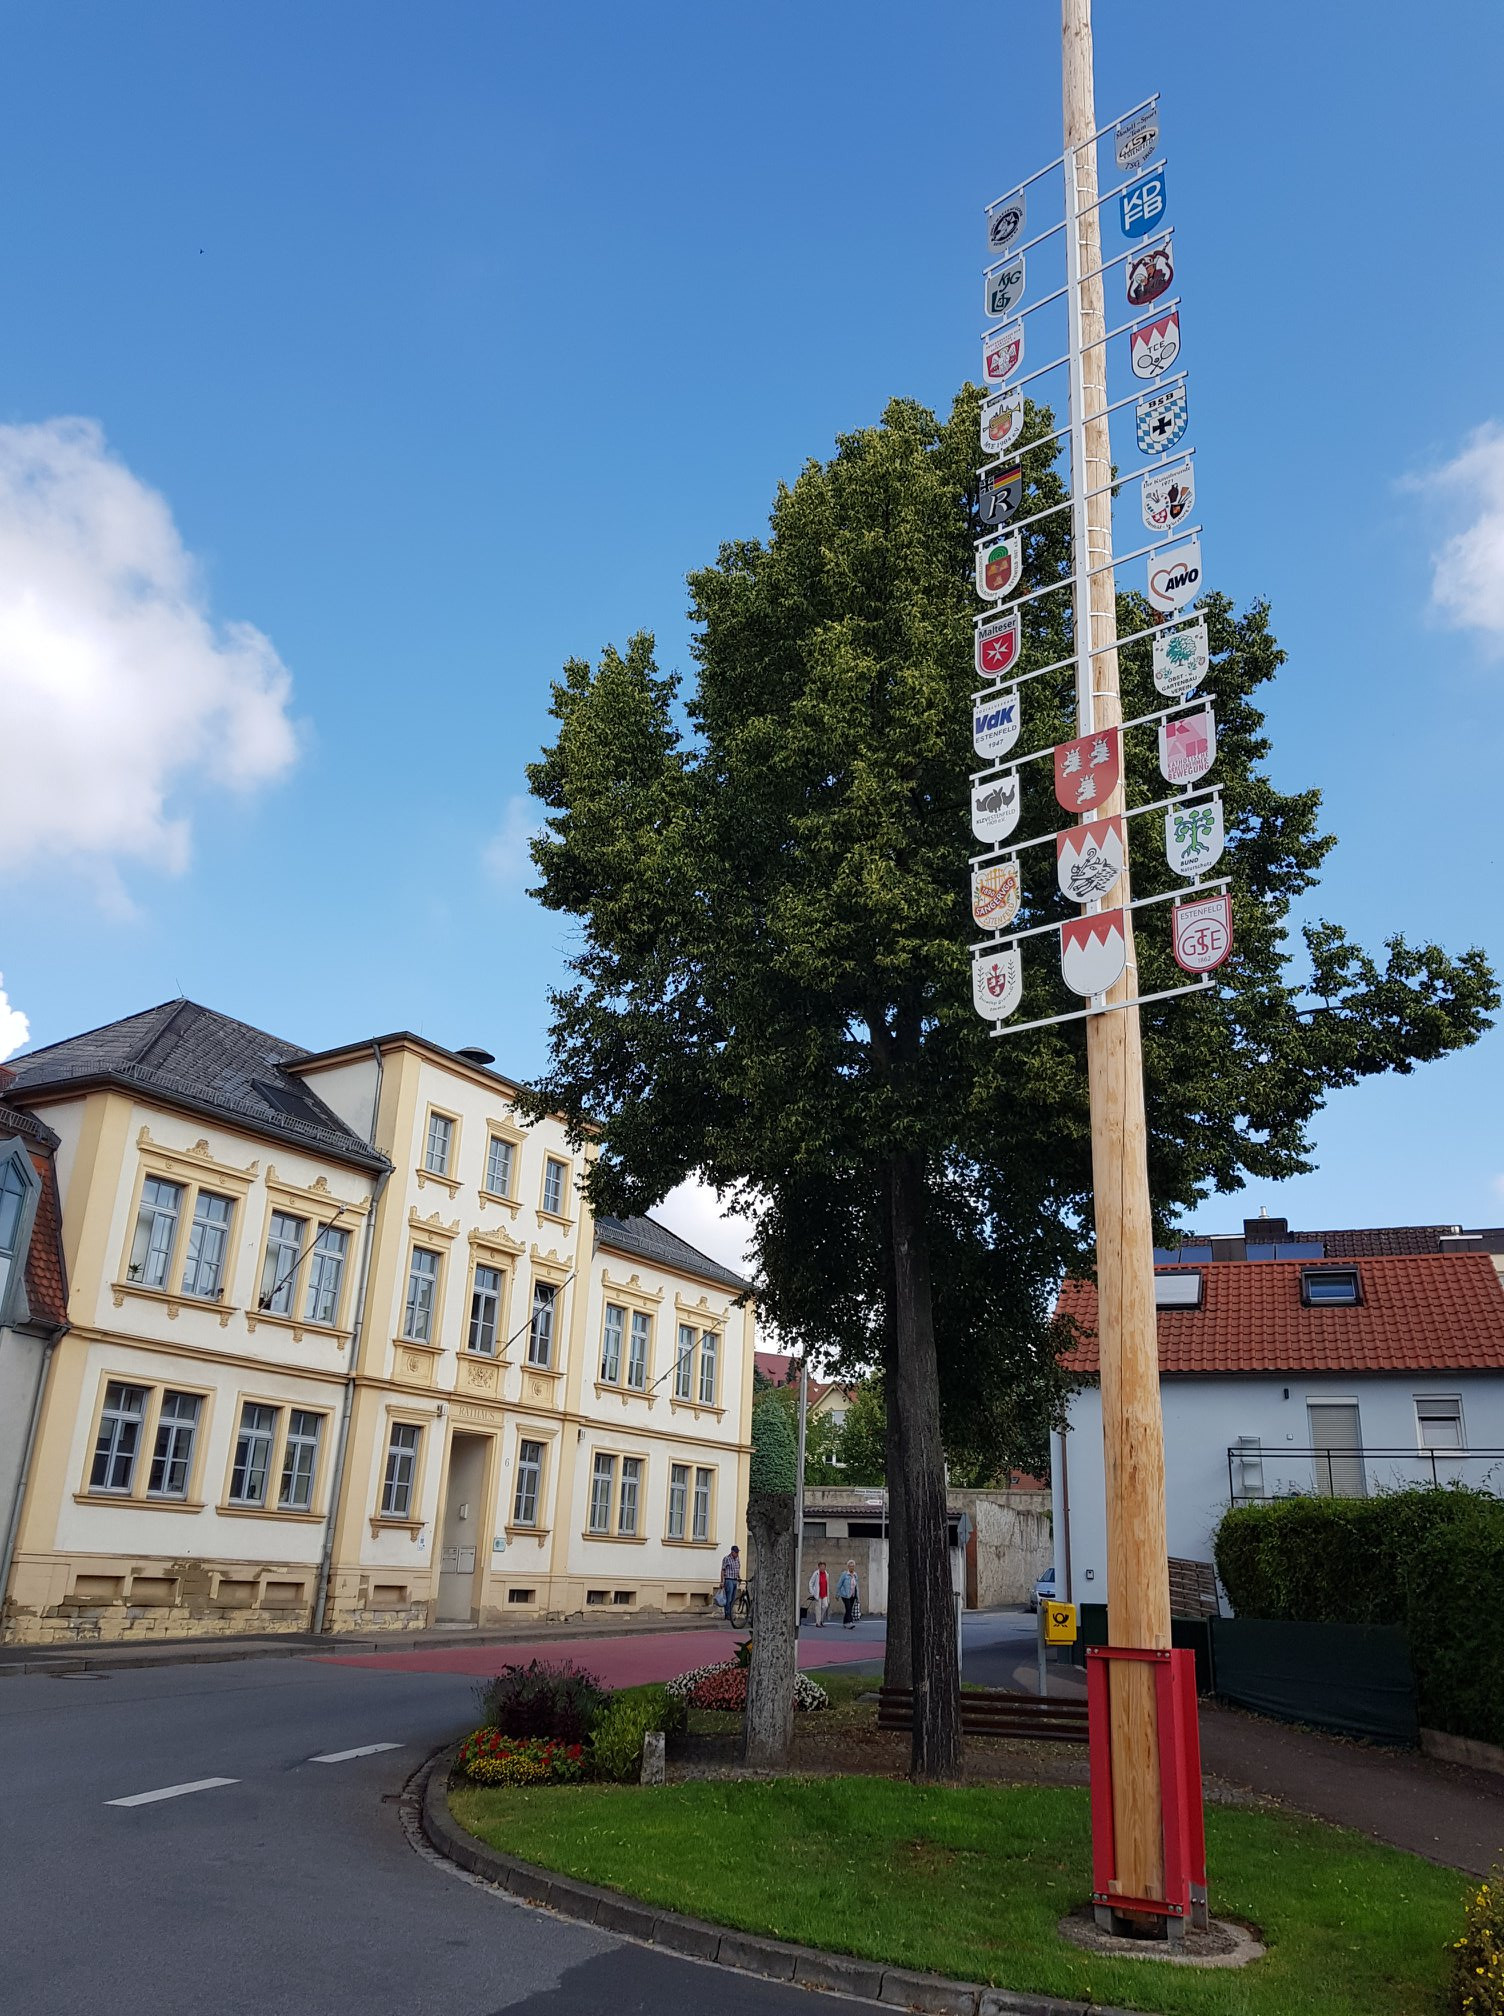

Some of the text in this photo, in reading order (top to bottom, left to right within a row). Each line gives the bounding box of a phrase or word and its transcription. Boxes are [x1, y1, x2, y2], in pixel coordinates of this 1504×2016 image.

[1146, 340, 1166, 354] TCE
[1148, 392, 1174, 408] BSB
[986, 487, 1015, 520] R
[1165, 568, 1199, 593] AWO
[979, 620, 1017, 639] Malteser
[1170, 684, 1192, 694] VEREIN
[975, 704, 1016, 735] VdK
[975, 725, 1017, 743] ESTENFELD
[988, 739, 1004, 749] 1947
[1167, 762, 1210, 781] BEWEGUNG
[1180, 857, 1199, 867] BUND
[1180, 861, 1212, 873] Naturschutz
[1180, 904, 1223, 920] ESTENFELD
[458, 1406, 495, 1421] RATHAUS
[504, 1457, 510, 1467] 6
